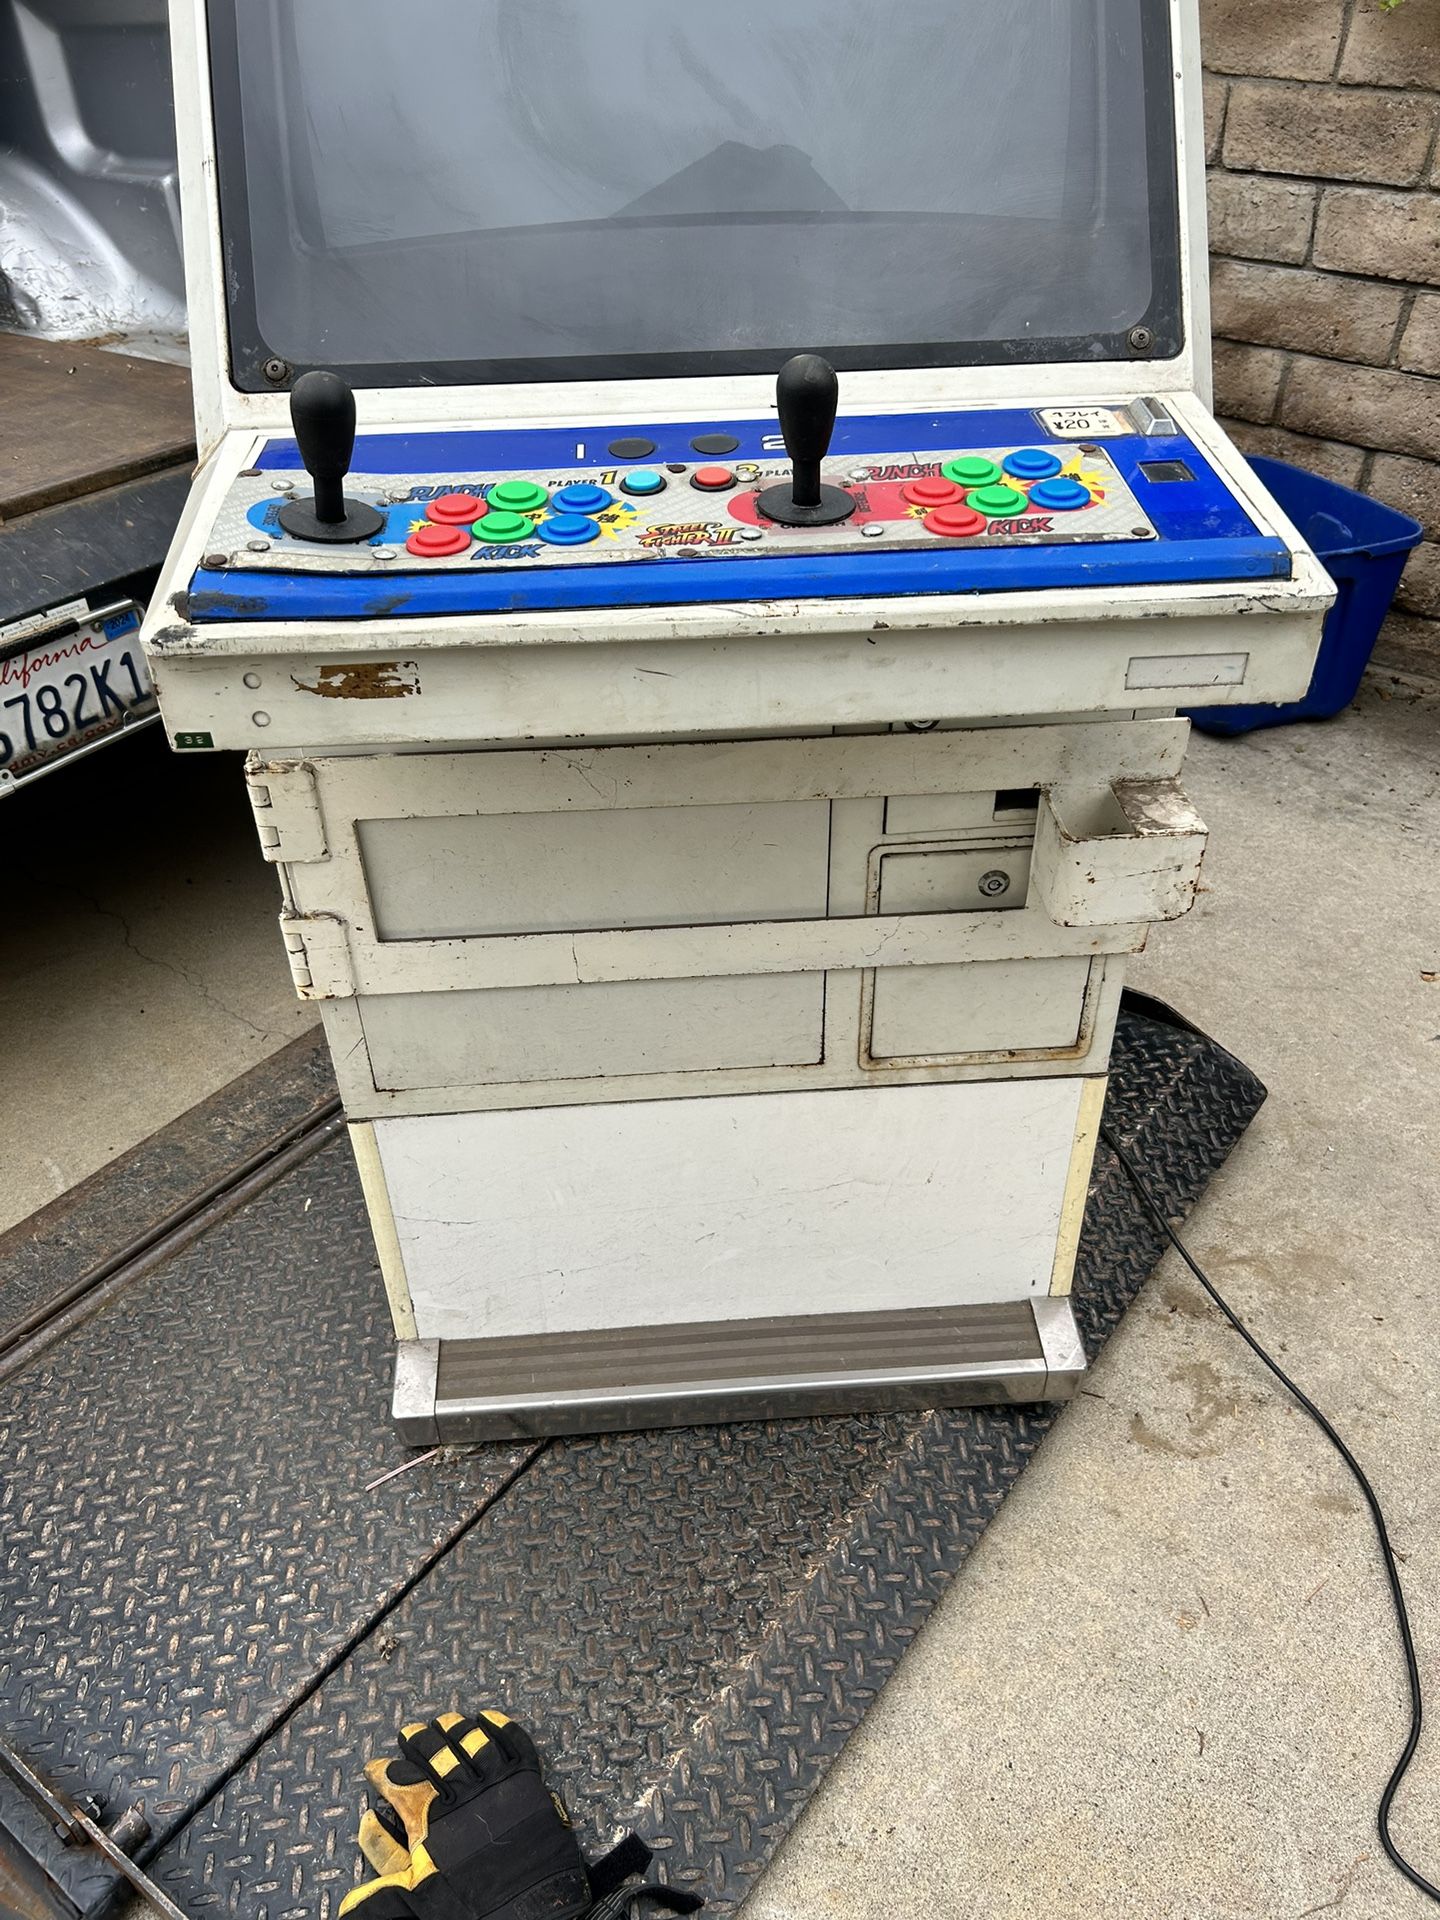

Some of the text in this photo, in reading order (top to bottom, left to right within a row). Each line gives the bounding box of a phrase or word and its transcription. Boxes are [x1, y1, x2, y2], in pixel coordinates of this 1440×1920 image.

[863, 463, 942, 480] PUNCH
[548, 479, 597, 487] PLAYER
[408, 483, 497, 501] PUNCH
[988, 517, 1054, 535] KICK
[470, 544, 547, 560] KICK
[0, 637, 110, 688] lifornia
